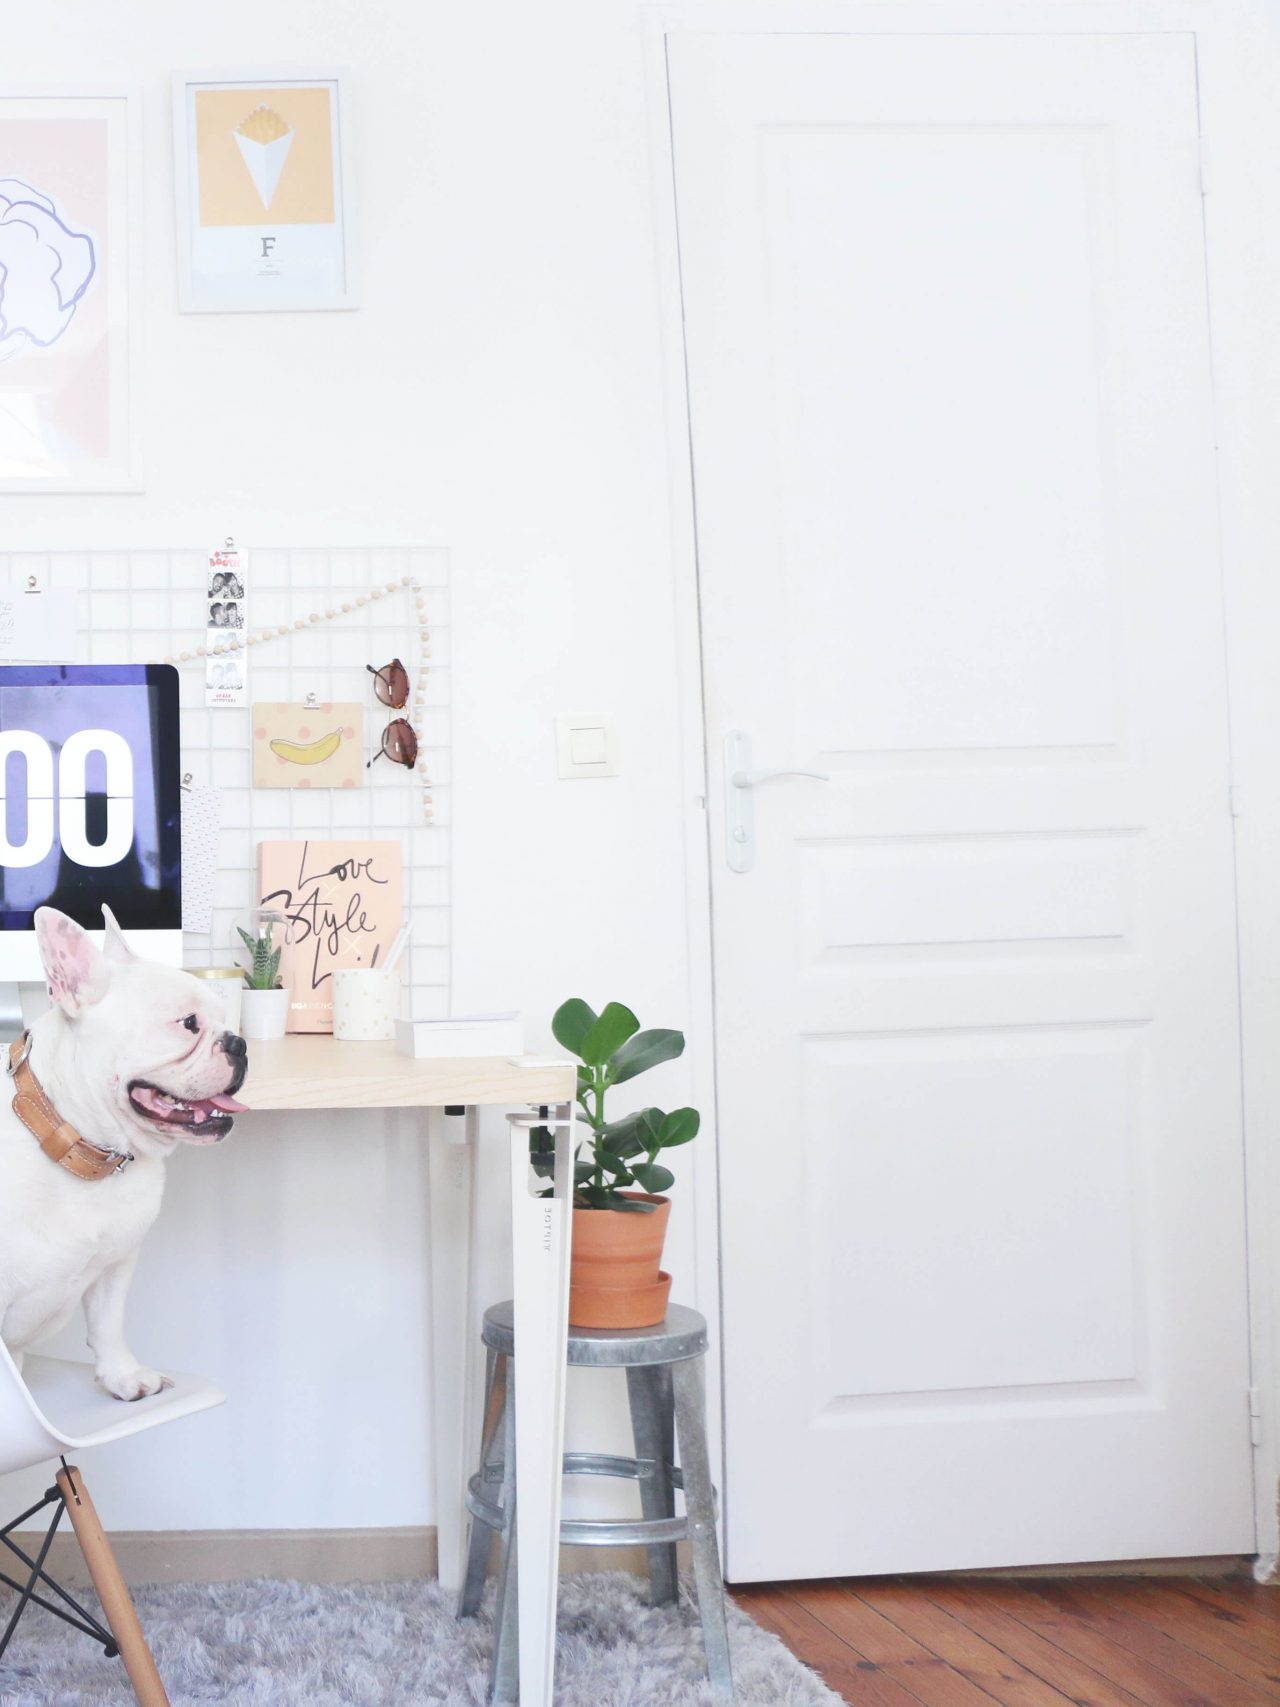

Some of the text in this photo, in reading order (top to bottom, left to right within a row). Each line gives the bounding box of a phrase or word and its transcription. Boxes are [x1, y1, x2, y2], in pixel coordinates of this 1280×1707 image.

[261, 237, 276, 257] F
[298, 840, 388, 890] Love
[261, 887, 376, 956] Style
